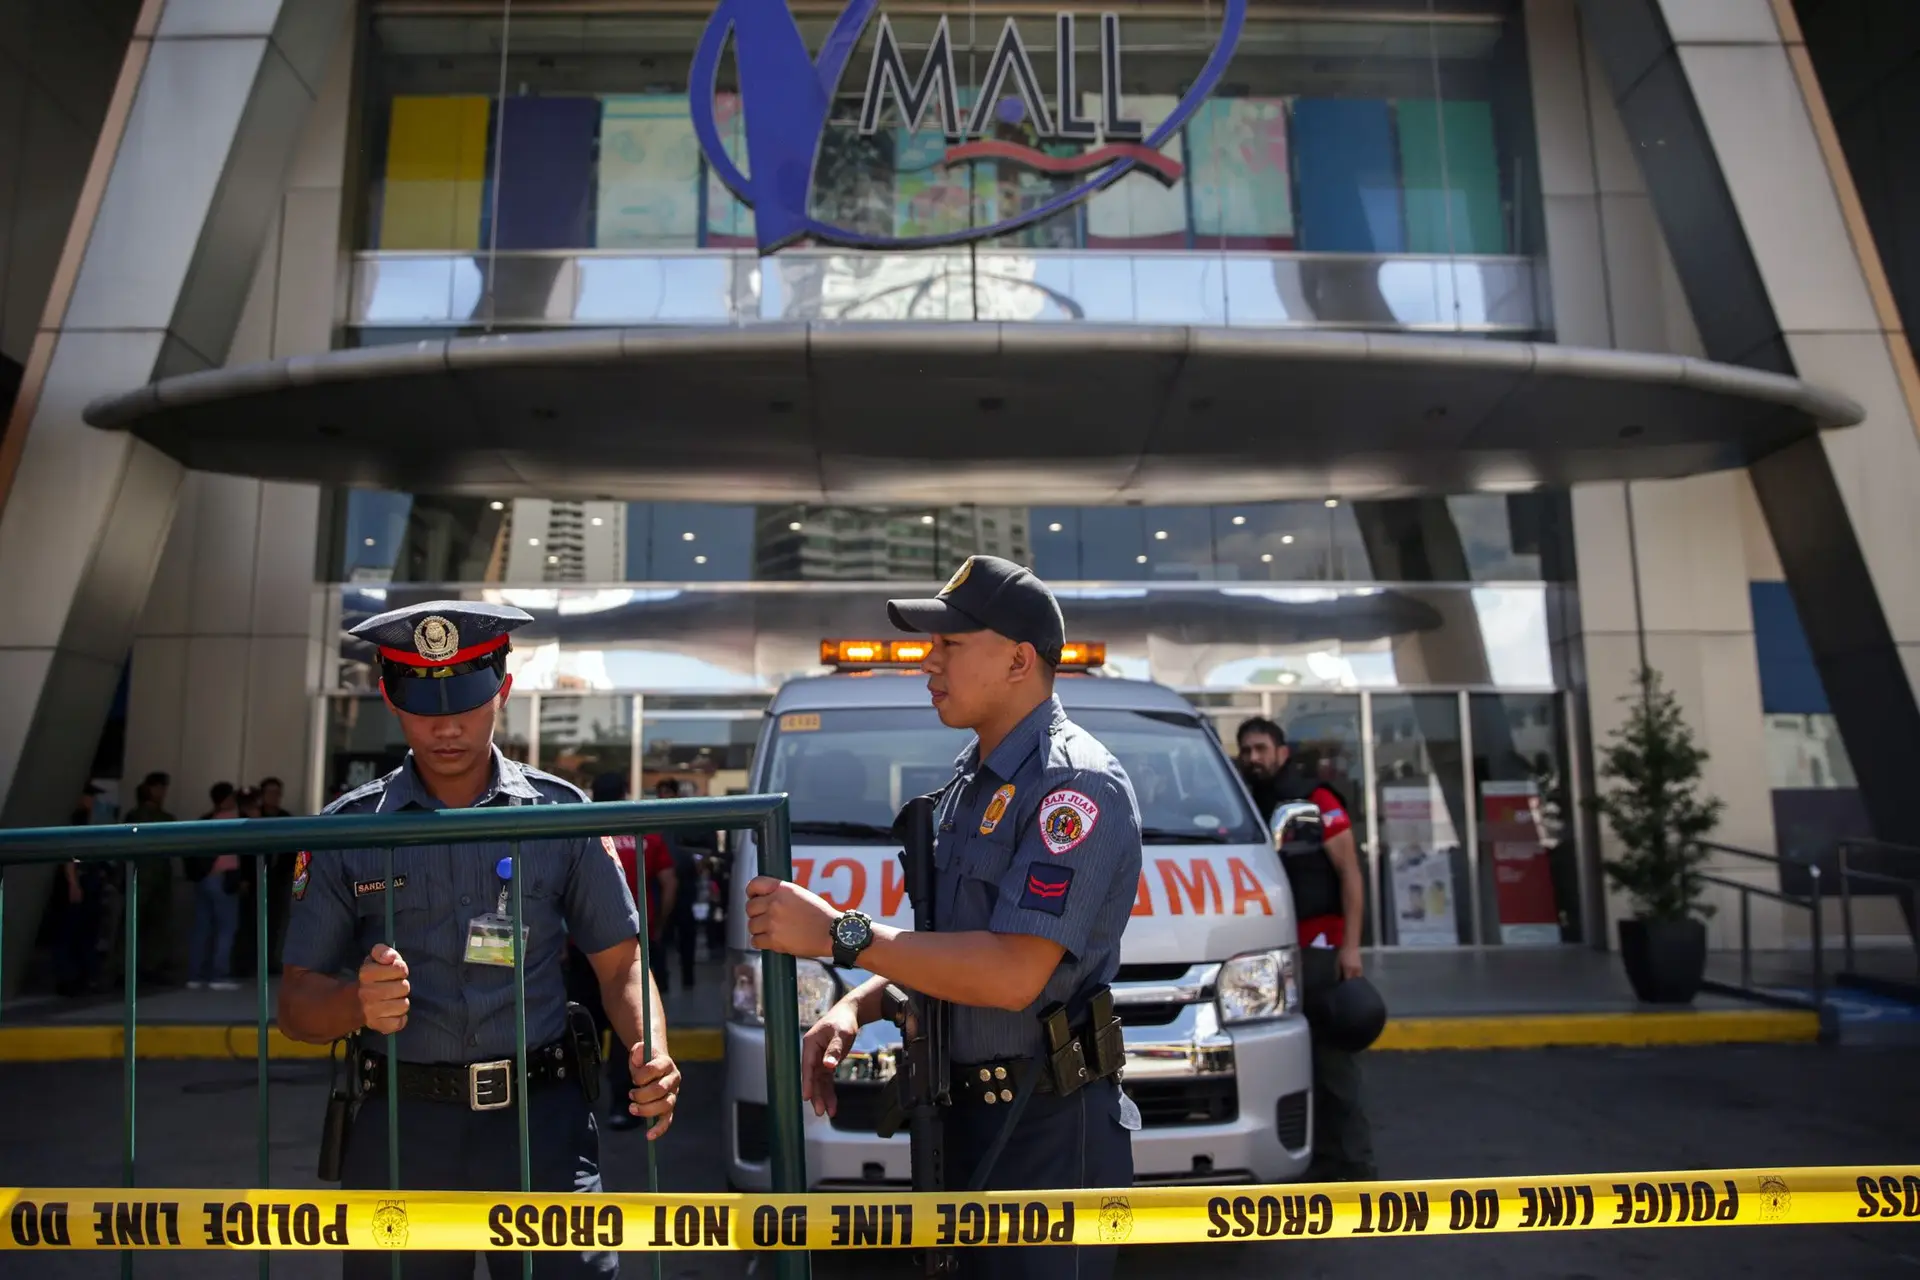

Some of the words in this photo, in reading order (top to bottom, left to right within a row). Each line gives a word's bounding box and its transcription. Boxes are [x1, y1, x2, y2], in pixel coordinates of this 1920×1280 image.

[857, 12, 1144, 139] MALL
[1045, 794, 1066, 805] SAN
[1068, 795, 1096, 814] JUAN
[358, 878, 404, 892] SANDOAL
[1207, 1193, 1333, 1238] CROSS
[1352, 1191, 1429, 1233] NOT
[1449, 1189, 1499, 1230] DO
[1518, 1184, 1595, 1228] LINE
[1612, 1180, 1739, 1225] POLICE
[1856, 1175, 1920, 1218] OSS
[11, 1201, 71, 1246] DO
[93, 1202, 181, 1246] LINE
[202, 1202, 349, 1246] POLICE
[488, 1204, 623, 1247] CROSS
[648, 1205, 729, 1246] NOT
[753, 1205, 807, 1246] DO
[831, 1205, 912, 1246] LINE
[936, 1201, 1075, 1245] POLICE
